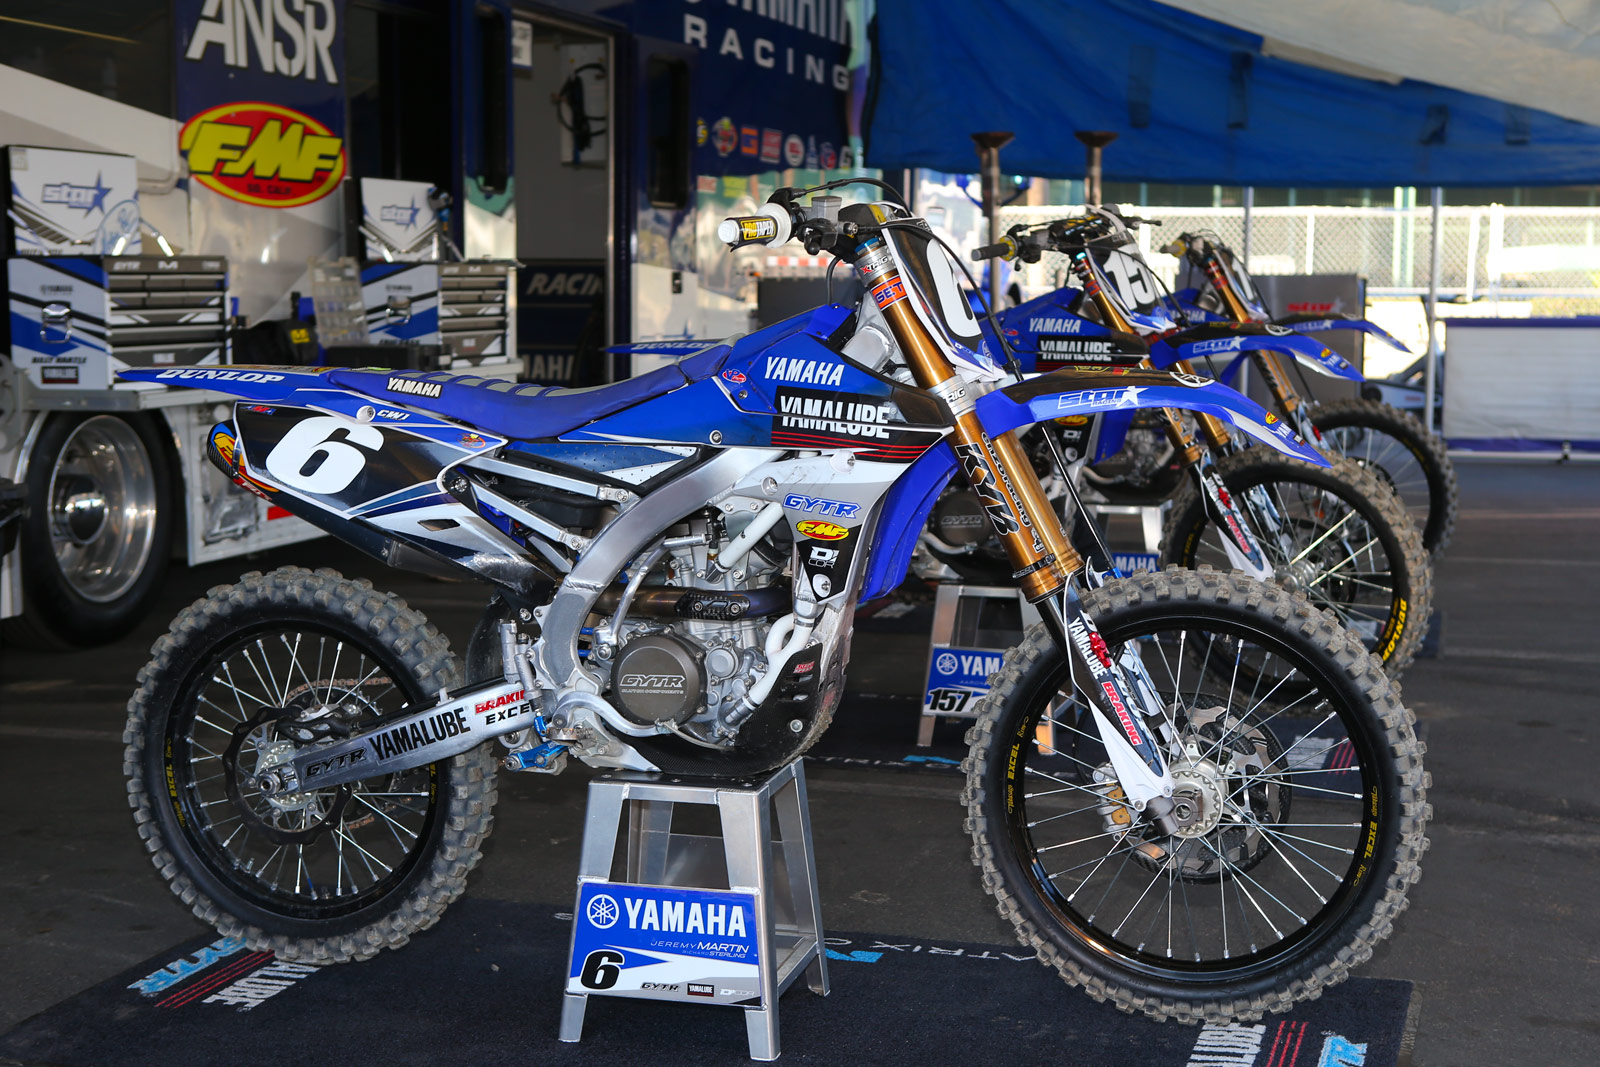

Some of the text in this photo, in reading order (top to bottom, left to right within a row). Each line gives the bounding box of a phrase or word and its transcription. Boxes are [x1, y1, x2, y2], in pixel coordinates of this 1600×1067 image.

[186, 0, 338, 84] ANSR
[684, 13, 849, 91] RACING
[188, 119, 343, 182] FMF
[526, 273, 603, 297] RACIN
[1029, 318, 1082, 333] YAMAHA
[1040, 340, 1112, 361] YAMALUBE
[156, 369, 285, 383] DUNLOP
[764, 356, 845, 386] YAMAHA
[386, 377, 441, 398] YAMAHA
[779, 395, 891, 440] YAMALUBE
[265, 416, 385, 495] 6
[955, 442, 1021, 535] KYB
[783, 492, 861, 519] GYTR
[800, 522, 849, 537] FMF
[1115, 556, 1157, 573] MAHA
[1069, 616, 1109, 680] YAMALUBE
[620, 673, 686, 688] GYTR
[960, 655, 1000, 677] YAM
[475, 689, 526, 715] BRAKI
[486, 703, 530, 726] EXCE
[928, 688, 973, 713] 157
[1101, 680, 1143, 747] BRAKING
[369, 707, 471, 760] YAMALUBE
[305, 747, 367, 779] GYTR
[1007, 743, 1020, 780] EXCEL
[165, 764, 178, 797] EXCEL
[1363, 821, 1378, 860] EXCEL
[623, 897, 747, 938] YAMAHA
[650, 940, 750, 954] JEREMY MARTIN
[709, 950, 747, 959] STERLING
[579, 949, 626, 991] 6
[202, 960, 321, 1011] ALUBE
[641, 982, 680, 993] GYTR
